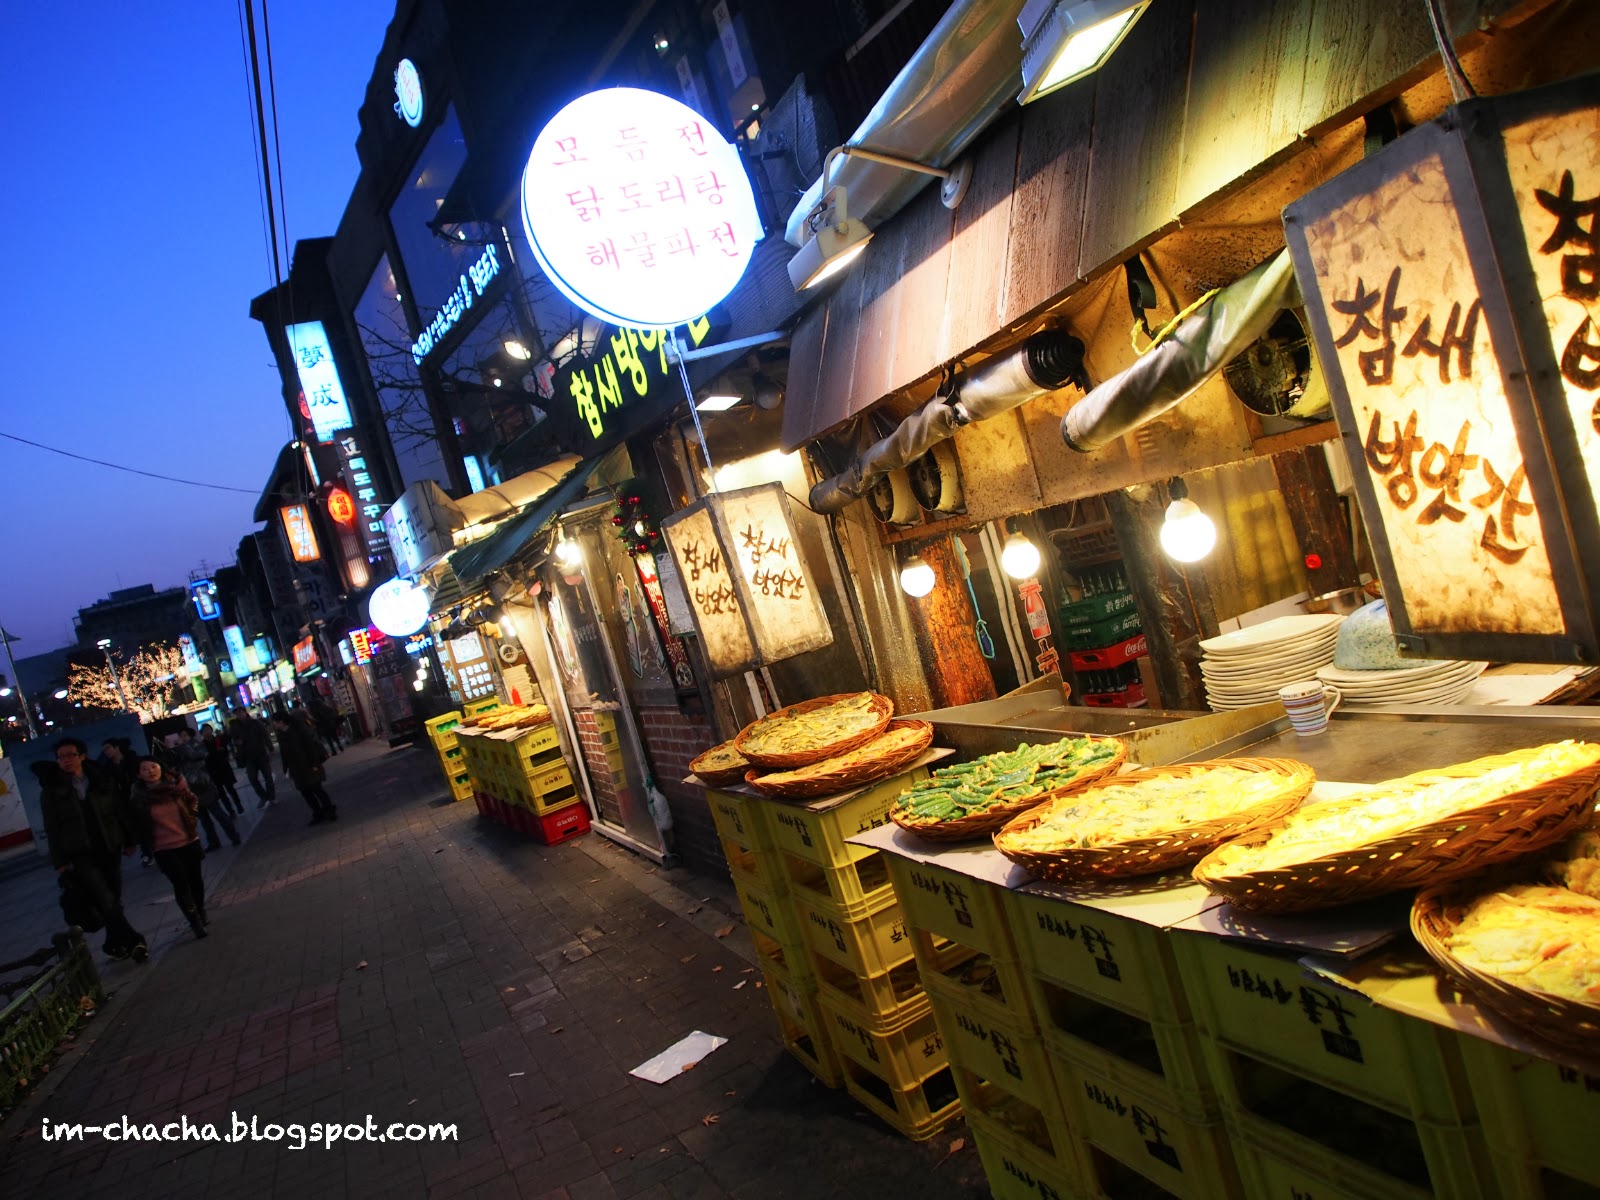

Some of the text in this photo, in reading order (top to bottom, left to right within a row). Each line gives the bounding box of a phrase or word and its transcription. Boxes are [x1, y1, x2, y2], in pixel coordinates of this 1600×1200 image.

[566, 171, 727, 222] 닭도리탕
[585, 221, 740, 271] 해물파전
[1331, 265, 1483, 387] 참새
[1365, 408, 1536, 566] 방앗간
[682, 540, 720, 581] 참새
[739, 523, 790, 565] 참새
[695, 583, 737, 616] 방앗간
[753, 567, 806, 601] 방앗간
